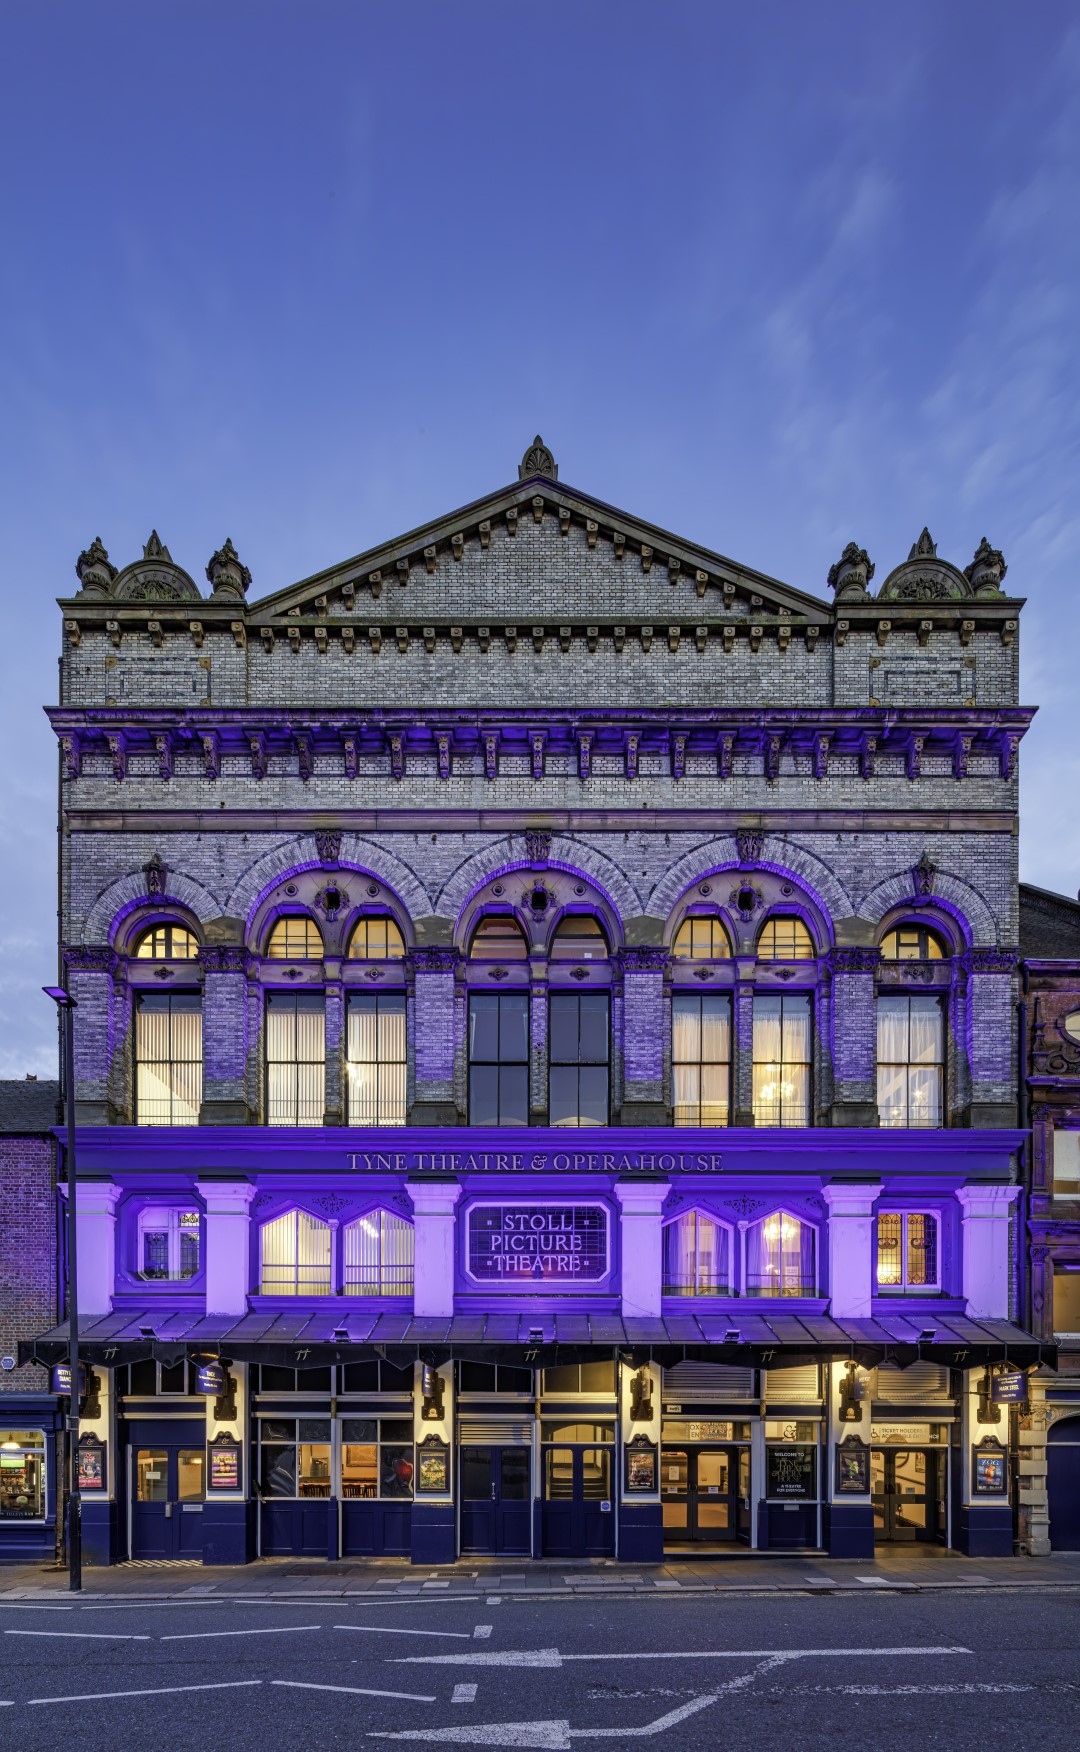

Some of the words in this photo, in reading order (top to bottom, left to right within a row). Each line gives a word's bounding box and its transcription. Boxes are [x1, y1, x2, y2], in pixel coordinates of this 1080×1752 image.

[347, 1153, 408, 1171] TYNE
[412, 1153, 524, 1171] THEATRE
[530, 1154, 547, 1171] &
[553, 1153, 637, 1172] OPERA
[638, 1153, 724, 1172] HOUSE
[503, 1214, 573, 1231] STOLL
[490, 1234, 582, 1251] PICTURE
[492, 1255, 581, 1272] THEATRE
